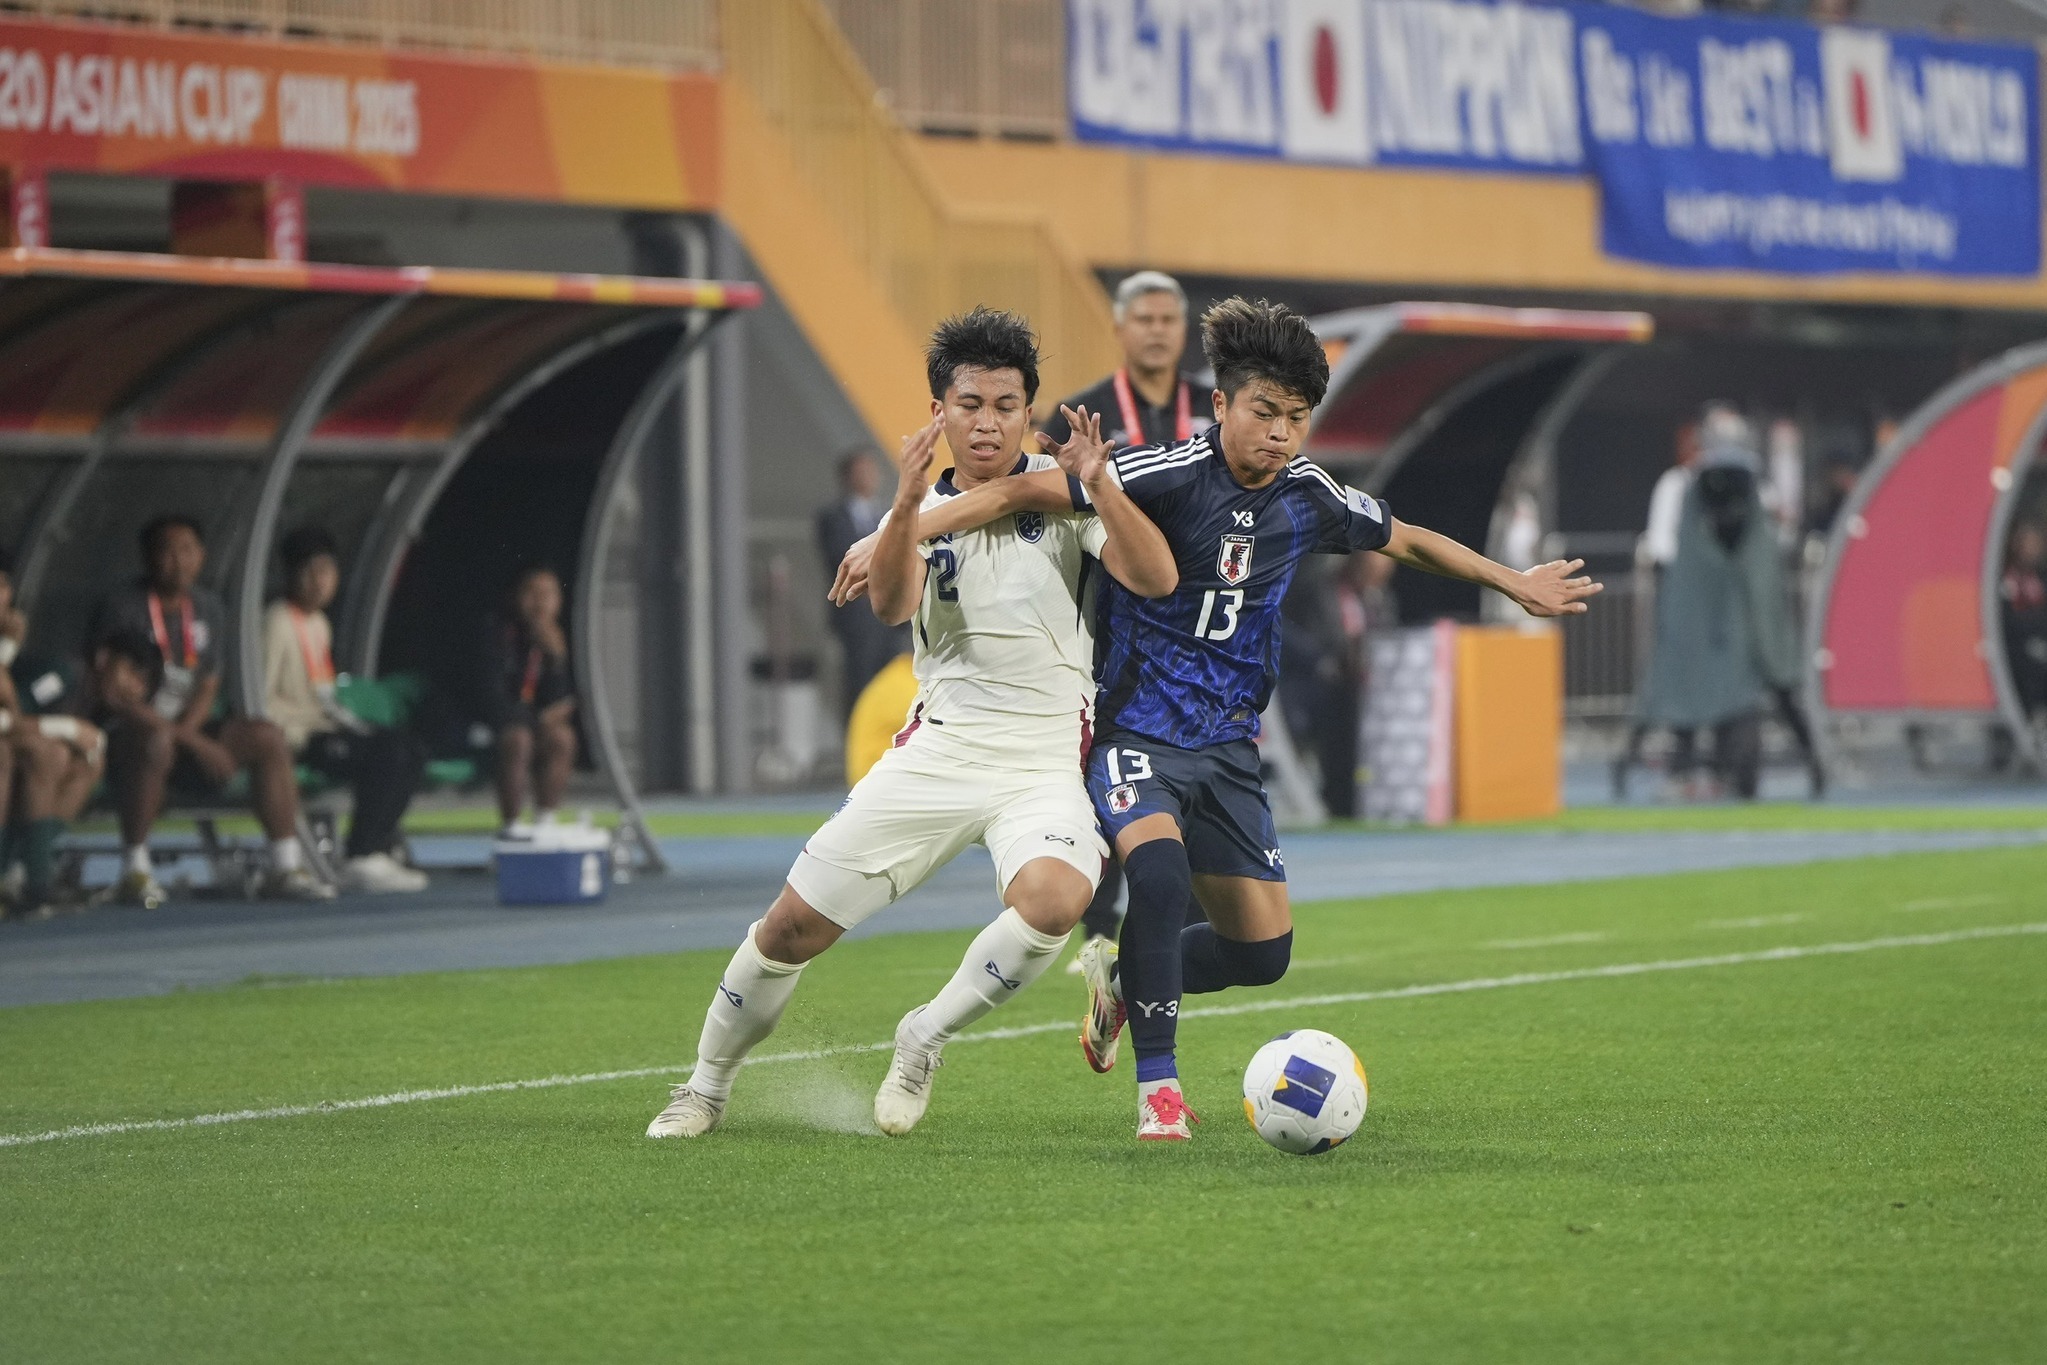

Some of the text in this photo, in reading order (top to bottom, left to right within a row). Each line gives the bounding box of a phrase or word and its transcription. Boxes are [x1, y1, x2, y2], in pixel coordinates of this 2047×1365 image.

[50, 53, 176, 138] ASIAN
[180, 66, 266, 143] CUP
[931, 549, 959, 602] 2
[1195, 588, 1244, 640] 13
[1106, 747, 1153, 785] 13
[1135, 1000, 1178, 1018] Y-3
